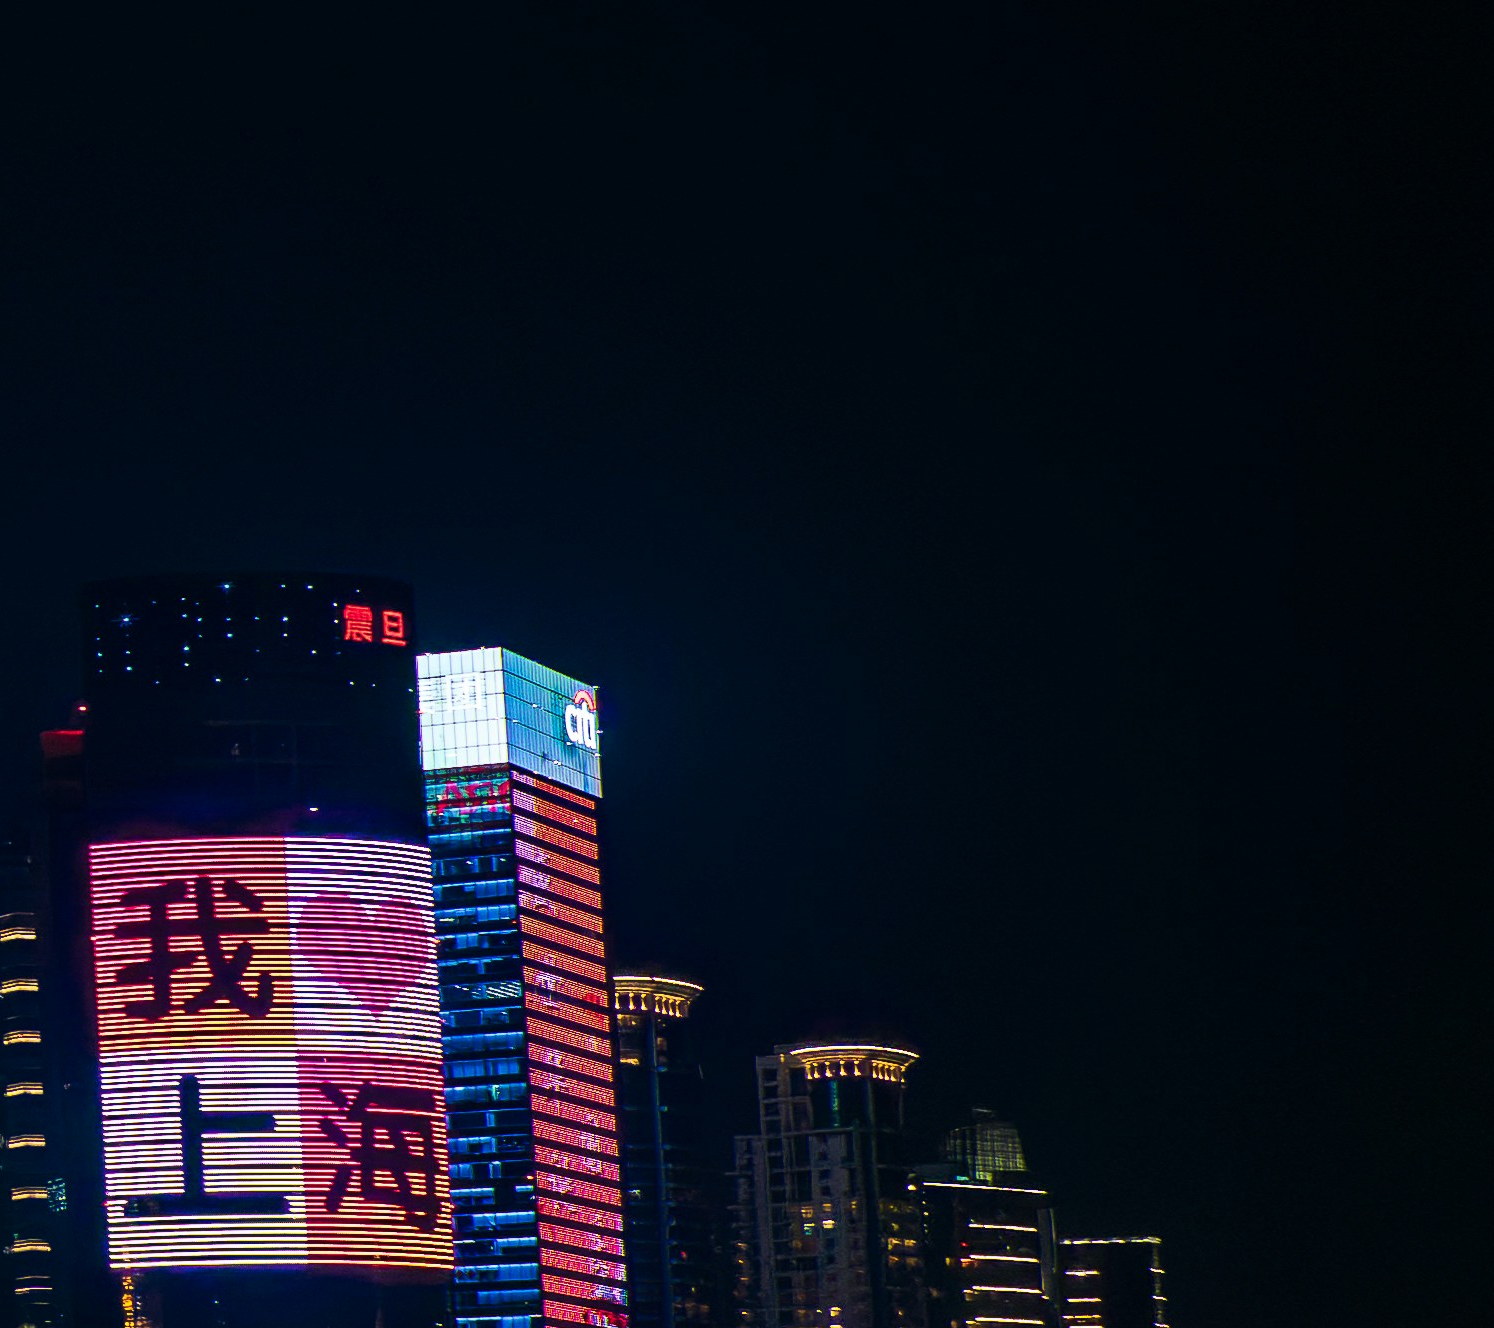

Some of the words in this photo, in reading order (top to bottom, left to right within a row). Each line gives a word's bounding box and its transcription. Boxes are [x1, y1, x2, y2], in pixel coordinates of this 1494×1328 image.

[343, 603, 407, 647] 震旦
[565, 698, 598, 750] citi
[116, 874, 272, 1021] 我
[122, 1073, 441, 1232] 上海
